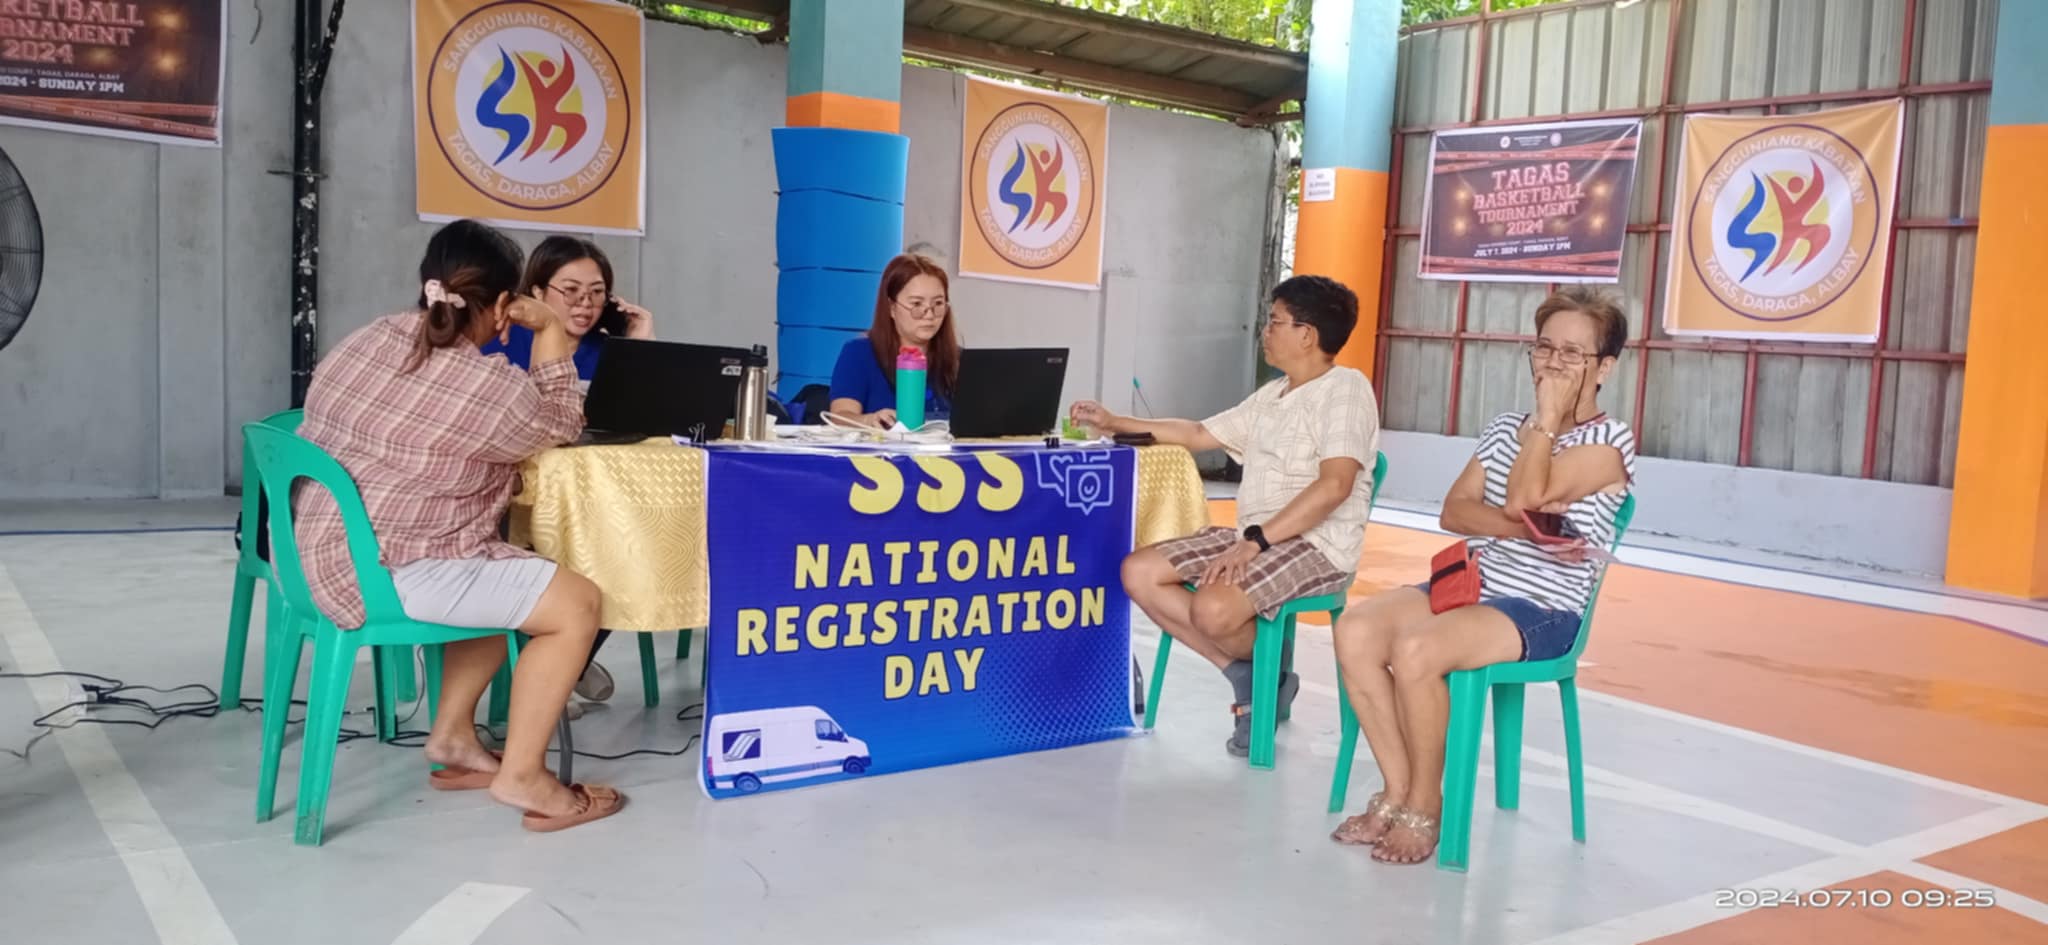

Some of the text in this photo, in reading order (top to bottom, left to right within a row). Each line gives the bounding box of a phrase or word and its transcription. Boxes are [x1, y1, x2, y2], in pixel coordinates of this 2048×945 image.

[3, 39, 74, 65] 2024
[443, 11, 618, 99] SANGGUNIANG KABATAAN
[38, 78, 97, 92] SUNDAY
[99, 82, 125, 93] 1PM
[448, 132, 615, 201] TAGAS, DARAGA, ALBAY
[1491, 161, 1571, 190] TAGAS
[1704, 134, 1801, 204] SANGGUNIANG
[1473, 182, 1585, 210] BASKETBALL
[1477, 200, 1579, 224] TOURNAMENT
[1506, 219, 1544, 236] 2024
[1704, 248, 1859, 312] TAGAS, DARAGA, ALBAY
[794, 534, 1076, 590] NATIONAL
[736, 587, 1106, 657] REGISTRATION
[883, 647, 986, 700] DAY
